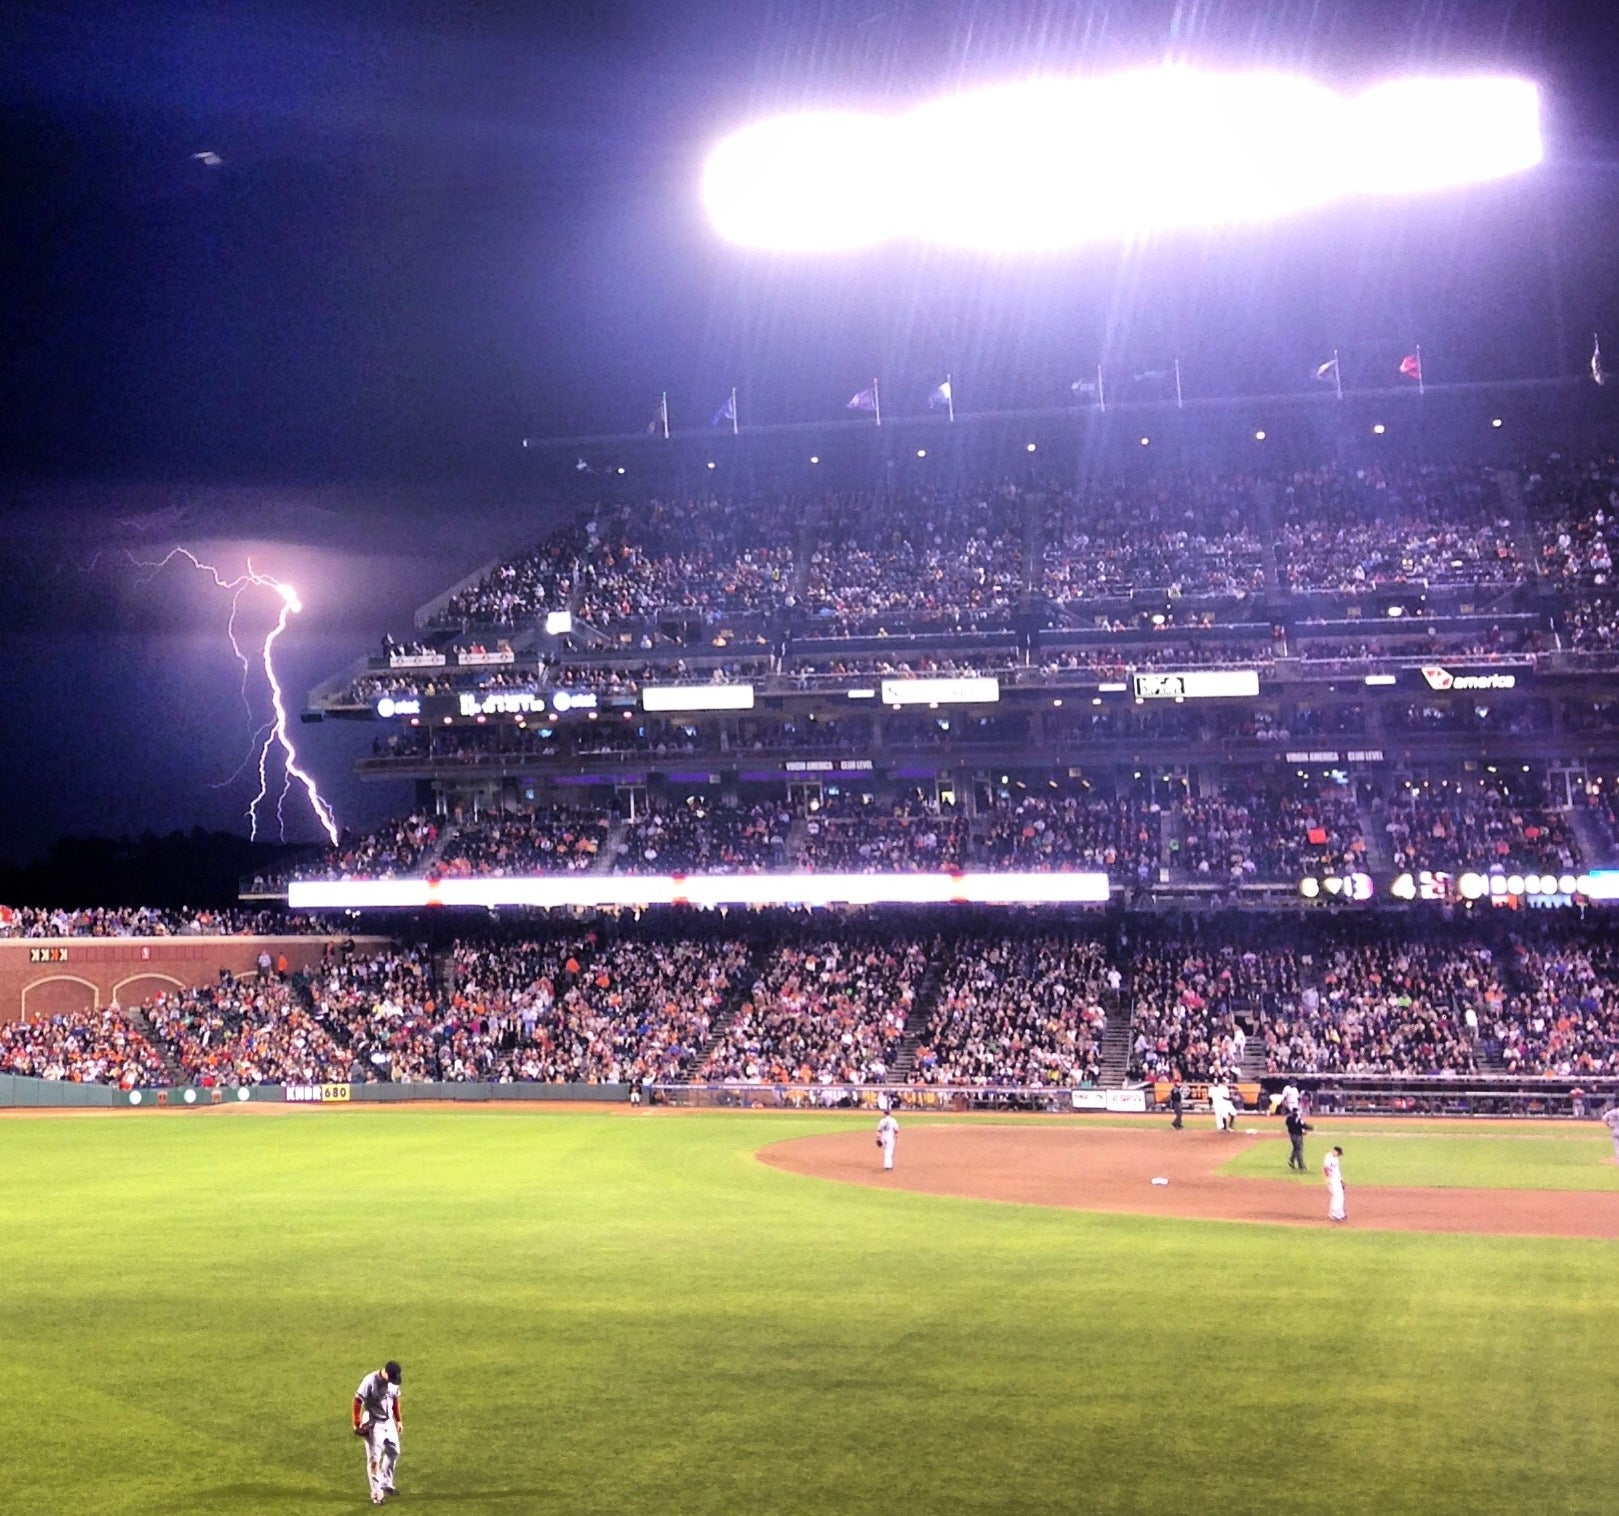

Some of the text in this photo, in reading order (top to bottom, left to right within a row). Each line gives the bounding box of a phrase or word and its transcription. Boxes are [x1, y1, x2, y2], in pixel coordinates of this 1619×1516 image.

[1453, 674, 1515, 689] america
[1309, 751, 1339, 762] AMERICA
[1347, 751, 1364, 761] CLUB
[1365, 750, 1385, 761] LEVEL
[806, 761, 834, 771] AMERICA
[856, 760, 873, 770] LEVEL
[286, 1086, 347, 1101] KNBR 680
